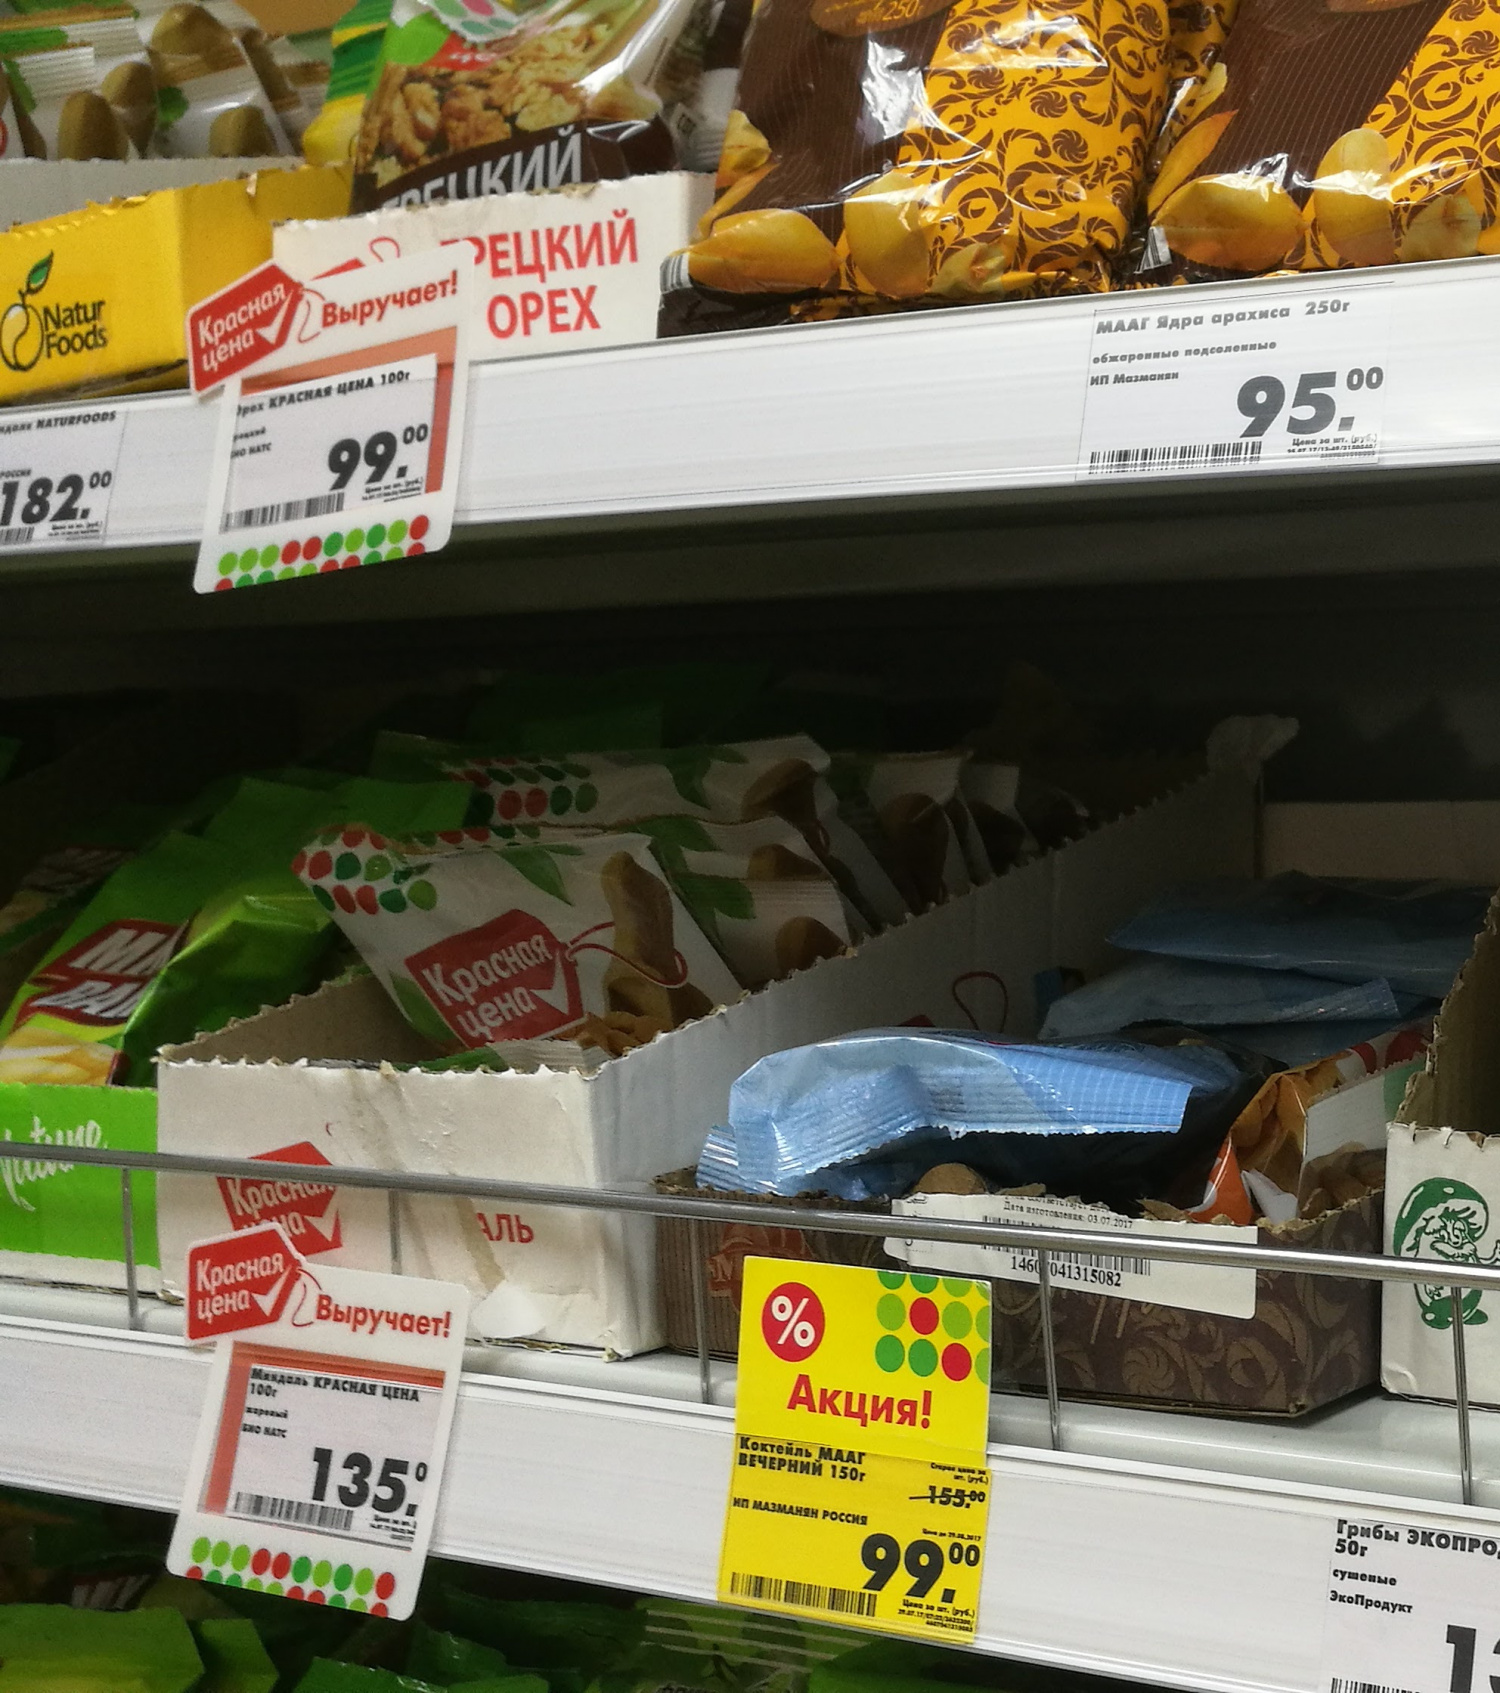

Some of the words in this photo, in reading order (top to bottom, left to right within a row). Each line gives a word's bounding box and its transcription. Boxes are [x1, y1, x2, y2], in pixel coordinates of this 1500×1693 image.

[43, 299, 105, 331] Natur
[198, 283, 287, 347] Красная
[321, 269, 459, 328] Выручает!
[487, 285, 601, 339] ОРЕХ
[1095, 317, 1150, 334] МААГ
[1156, 314, 1204, 331] Ядра
[1211, 305, 1290, 325] арахиса
[1305, 299, 1350, 315] 250г
[44, 324, 108, 358] Foods
[202, 327, 255, 372] цена
[1092, 348, 1180, 365] обжаренные
[1184, 340, 1277, 357] подсоленные
[269, 385, 333, 409] КРАСНАЯ
[337, 377, 375, 395] ЦЕНА
[380, 370, 410, 386] 100г
[1090, 374, 1109, 386] ИП
[1113, 370, 1179, 384] Мазманян
[1237, 372, 1355, 438] 95.
[1346, 366, 1384, 391] 00
[36, 410, 116, 429] NATURFOODS
[327, 430, 408, 491] 99.
[403, 423, 429, 445] 00
[0, 474, 90, 525] 182.
[89, 470, 112, 488] 00
[422, 934, 553, 1006] Красная
[456, 986, 537, 1040] цена
[1003, 1202, 1024, 1213] Дата
[1026, 1206, 1085, 1223] изготовления:
[1087, 1212, 1133, 1229] 03.07.2017
[196, 1252, 285, 1292] Красная
[1010, 1255, 1122, 1287] 1460041315082
[198, 1290, 251, 1321] цена
[316, 1293, 452, 1338] Выручает!
[250, 1382, 277, 1398] 100г
[251, 1368, 308, 1386] Миндаль
[313, 1376, 377, 1396] КРАСНАЯ
[381, 1385, 420, 1402] ЦЕНА
[787, 1373, 933, 1430] Акция!
[739, 1436, 813, 1459] Коктейль
[817, 1447, 866, 1465] МААГ
[312, 1447, 418, 1517] 135.
[738, 1453, 823, 1478] ВЕЧЕРНИЙ
[830, 1464, 866, 1483] 150г
[733, 1498, 750, 1510] ИП
[752, 1500, 819, 1521] МАЗМАНЯН
[822, 1511, 868, 1525] РОССИЯ
[1336, 1518, 1400, 1542] Грибы
[1335, 1538, 1368, 1558] 50г
[860, 1533, 956, 1604] 99.
[949, 1542, 981, 1567] 00
[1333, 1568, 1398, 1586] сушеные
[1329, 1590, 1413, 1615] ЭкоПродукт
